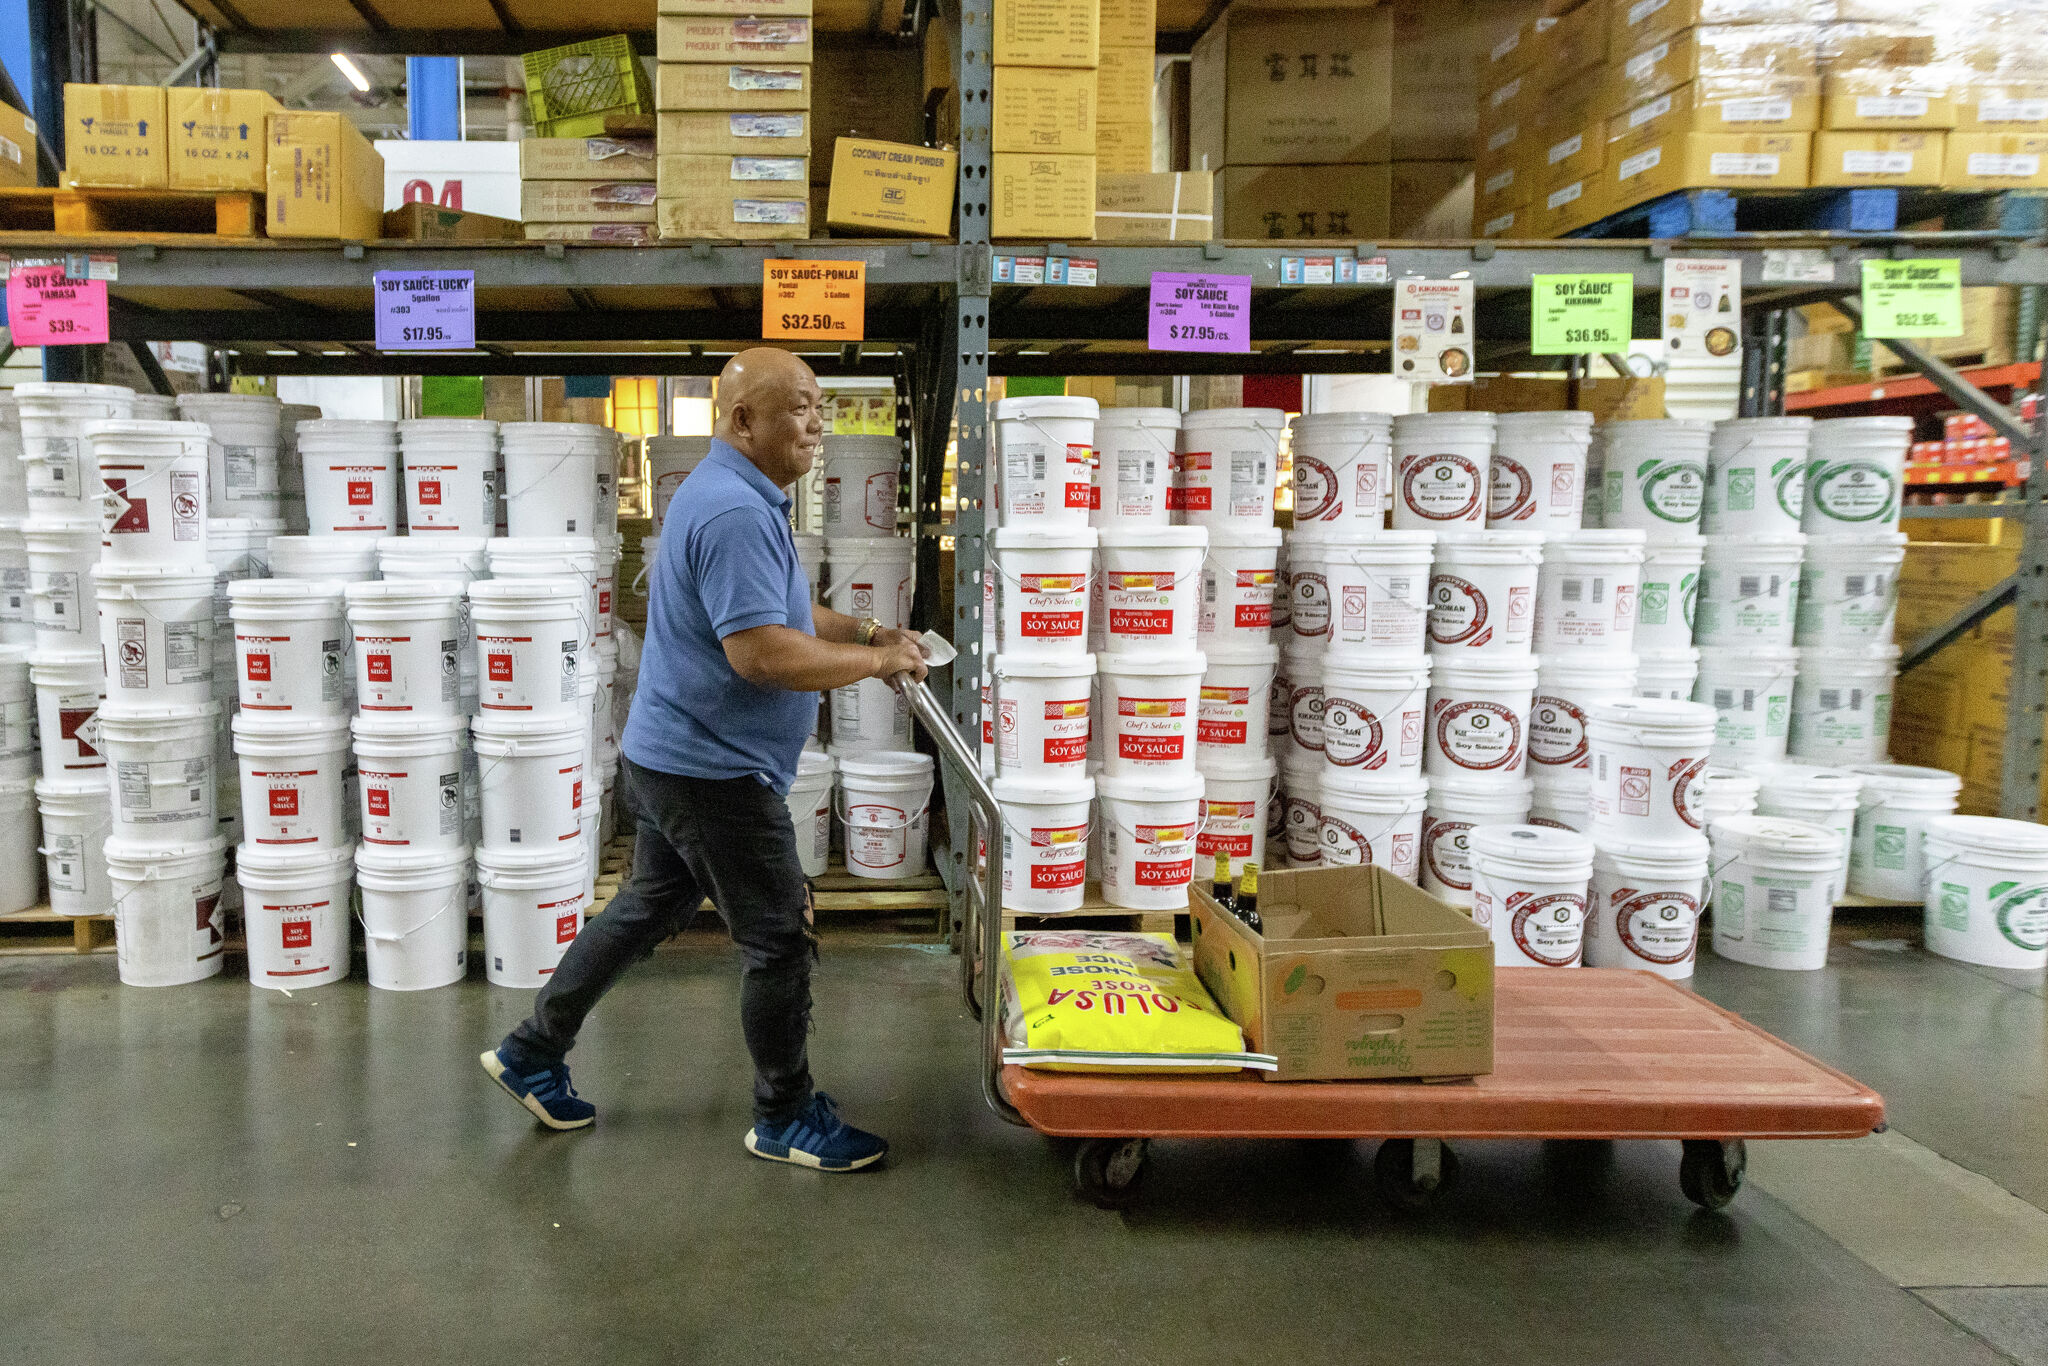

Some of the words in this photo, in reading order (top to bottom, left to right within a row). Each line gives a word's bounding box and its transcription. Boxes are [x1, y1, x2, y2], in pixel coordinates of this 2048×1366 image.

[84, 146, 96, 155] 16
[100, 146, 119, 156] OZ.
[136, 147, 149, 156] 24
[185, 148, 197, 157] 16
[201, 149, 221, 158] OZ.
[236, 151, 249, 160] 24
[852, 148, 887, 160] COCONUT
[888, 152, 913, 164] CREAM
[915, 155, 944, 167] POWDER
[771, 269, 790, 280] SOY
[791, 269, 859, 280] SAUCE-PONLAI
[25, 275, 47, 288] SOY
[381, 280, 400, 292] SOY
[403, 279, 469, 291] SAUCE-LUCKY
[1555, 283, 1576, 296] SOY
[1578, 282, 1613, 295] SAUCE
[40, 290, 76, 299] YAMASA
[412, 294, 441, 303] 5gallon
[1175, 288, 1195, 300] SOY
[1196, 289, 1228, 301] SAUCE
[1565, 297, 1602, 306] KIKKOMAN
[1170, 325, 1179, 339] $
[355, 487, 367, 495] soy
[424, 486, 435, 495] soy
[1029, 598, 1053, 608] Chef's
[1053, 598, 1074, 606] Select
[1114, 595, 1134, 604] Chef's
[1136, 595, 1157, 604] Select
[1240, 612, 1258, 622] SOY
[1027, 621, 1048, 630] SOY
[1051, 620, 1080, 630] SAUCE
[1113, 617, 1132, 627] SOY
[1133, 618, 1168, 628] SAUCE
[370, 667, 389, 675] sauce
[1213, 708, 1232, 716] Select
[1053, 724, 1074, 733] Chef's
[1126, 721, 1149, 731] Chef's
[1151, 721, 1171, 730] Select
[1209, 728, 1242, 738] SAUCE
[1123, 743, 1145, 754] SOY
[1147, 744, 1181, 754] SAUCE
[1337, 739, 1361, 748] Sauce
[1456, 742, 1472, 750] Soy
[1050, 746, 1069, 757] SOY
[1221, 823, 1240, 831] Select
[1217, 842, 1249, 851] SAUCE
[1040, 851, 1061, 860] Chef's
[1063, 848, 1079, 857] Select
[1144, 848, 1165, 858] Chef's
[1167, 847, 1185, 856] Select
[1440, 861, 1455, 870] Soy
[1037, 872, 1058, 882] SOY
[1060, 870, 1084, 881] SAUCE
[1141, 870, 1163, 880] SOY
[1165, 868, 1191, 878] SAUCE
[557, 909, 577, 918] LUCKY
[286, 934, 309, 942] sauce
[1537, 938, 1554, 946] Soy
[1091, 980, 1154, 992] ROSE
